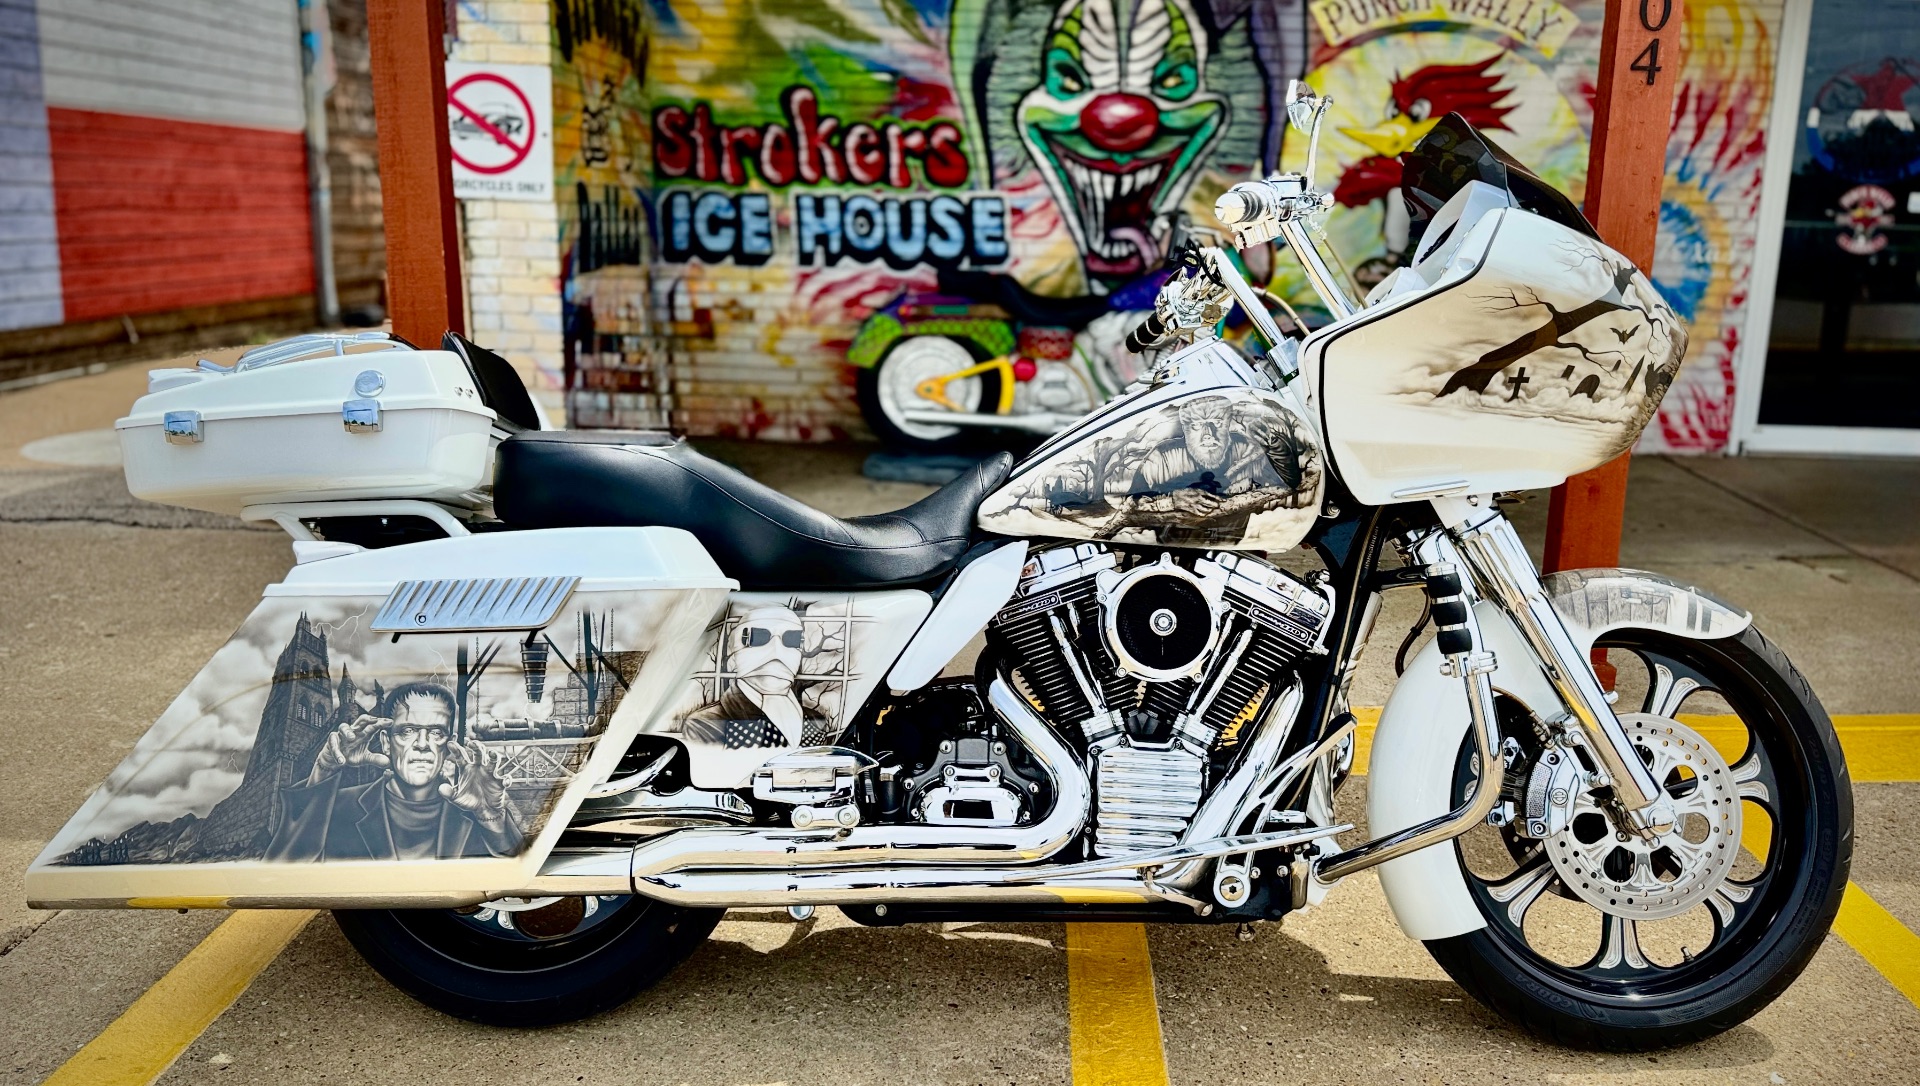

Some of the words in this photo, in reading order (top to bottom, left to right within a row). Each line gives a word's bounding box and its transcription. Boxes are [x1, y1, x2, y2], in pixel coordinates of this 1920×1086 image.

[653, 85, 971, 189] Strokers
[454, 180, 512, 192] ORCYCLES
[517, 182, 545, 193] ONLY
[667, 192, 773, 262] ICE
[797, 192, 1008, 264] HOUSE
[1515, 973, 1572, 1008] COBRA
